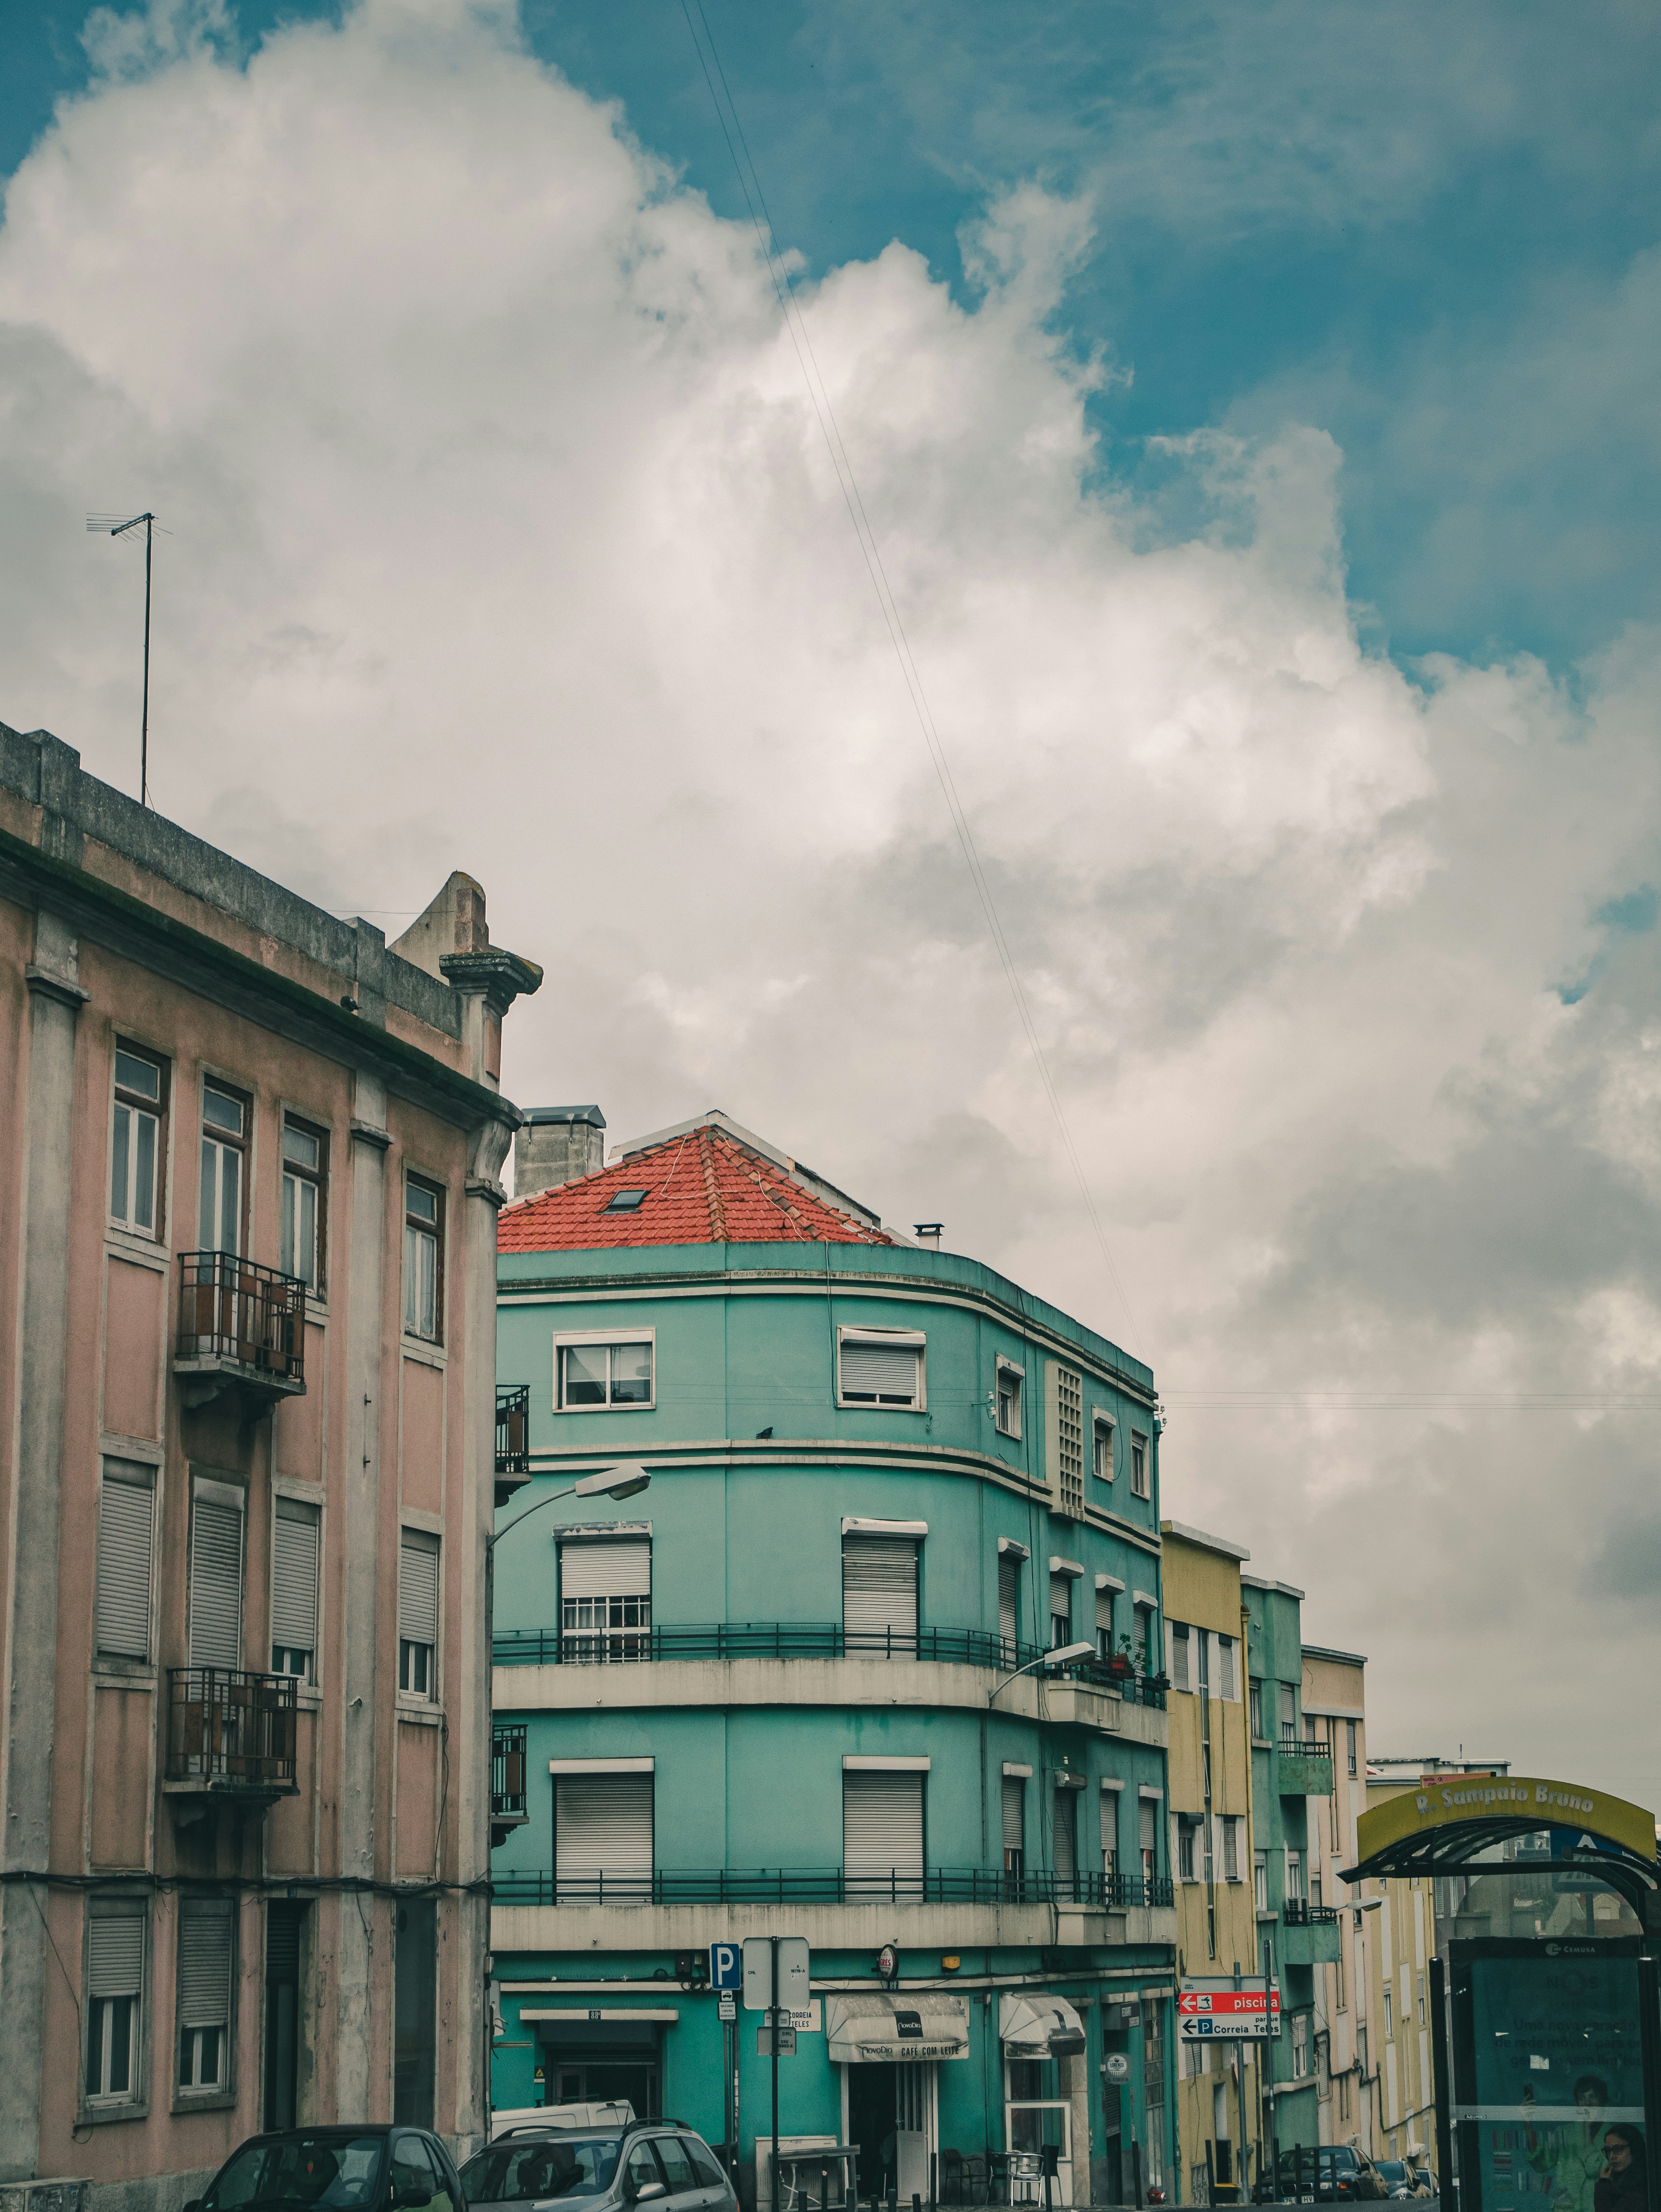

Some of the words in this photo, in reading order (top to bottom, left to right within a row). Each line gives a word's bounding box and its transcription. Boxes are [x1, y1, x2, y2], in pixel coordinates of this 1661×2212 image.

[1415, 1795, 1437, 1814] R.
[1441, 1781, 1528, 1807] Sampaio
[1535, 1784, 1594, 1813] Bruno
[717, 1947, 734, 1985] P
[889, 1981, 897, 1989] 88
[1202, 2023, 1210, 2033] P
[1214, 2025, 1249, 2034] Correia
[901, 2045, 918, 2056] CAFÉ
[922, 2046, 937, 2055] COM
[940, 2046, 959, 2055] LEITE
